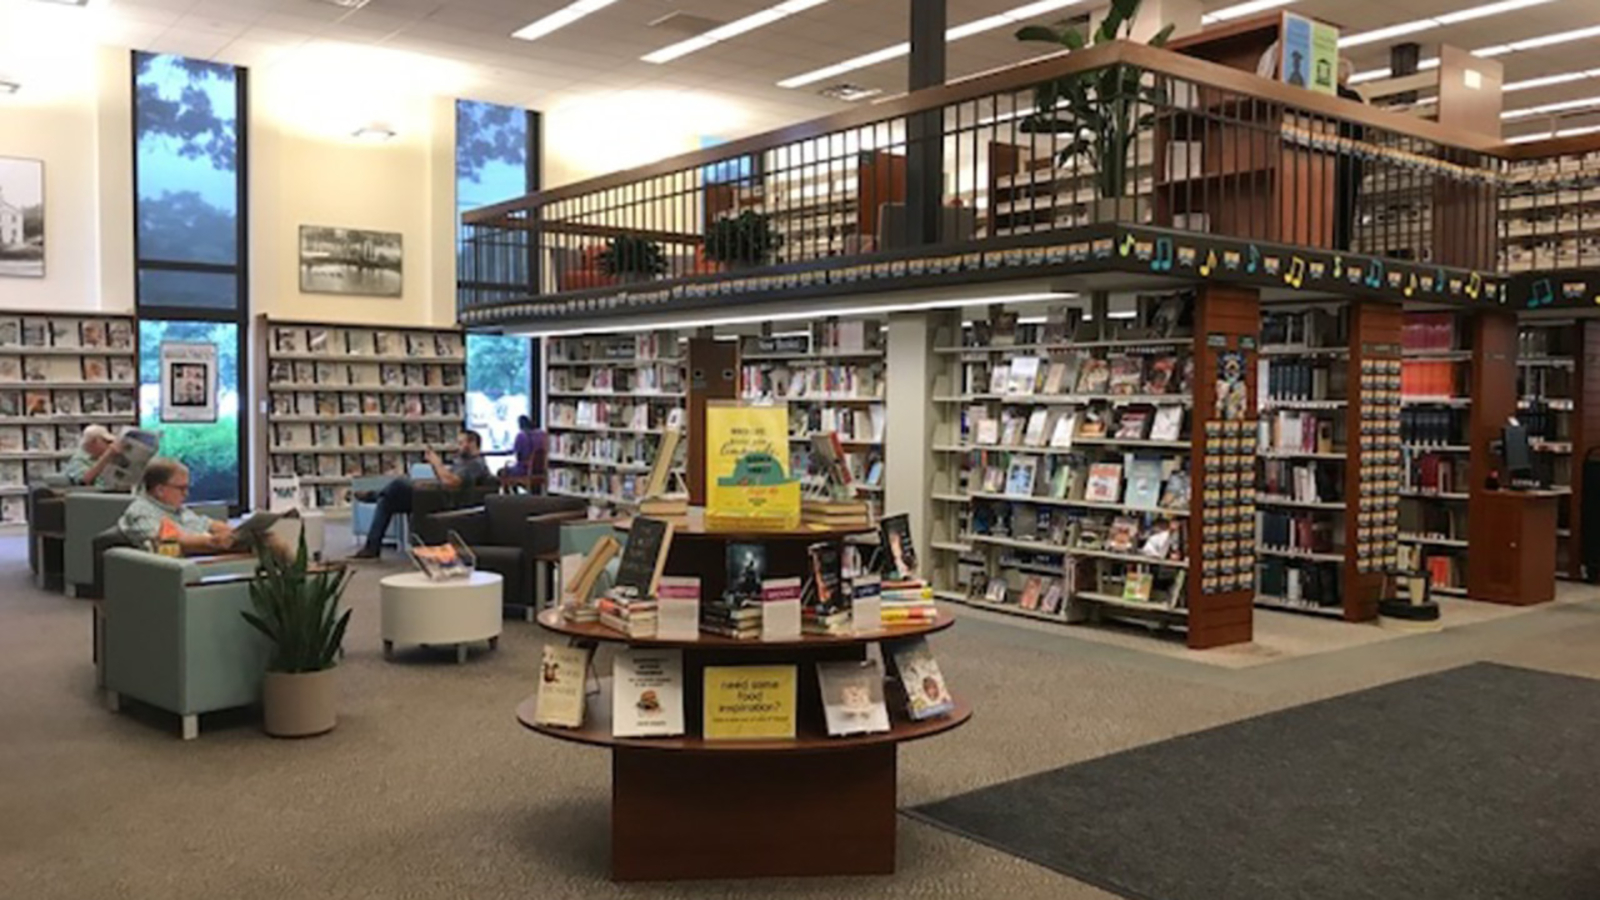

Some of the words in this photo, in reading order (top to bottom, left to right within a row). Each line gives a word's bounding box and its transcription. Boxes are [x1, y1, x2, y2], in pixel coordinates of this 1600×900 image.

[721, 679, 748, 690] need
[752, 681, 779, 689] some
[737, 691, 763, 701] food
[719, 701, 782, 713] inspiration?
